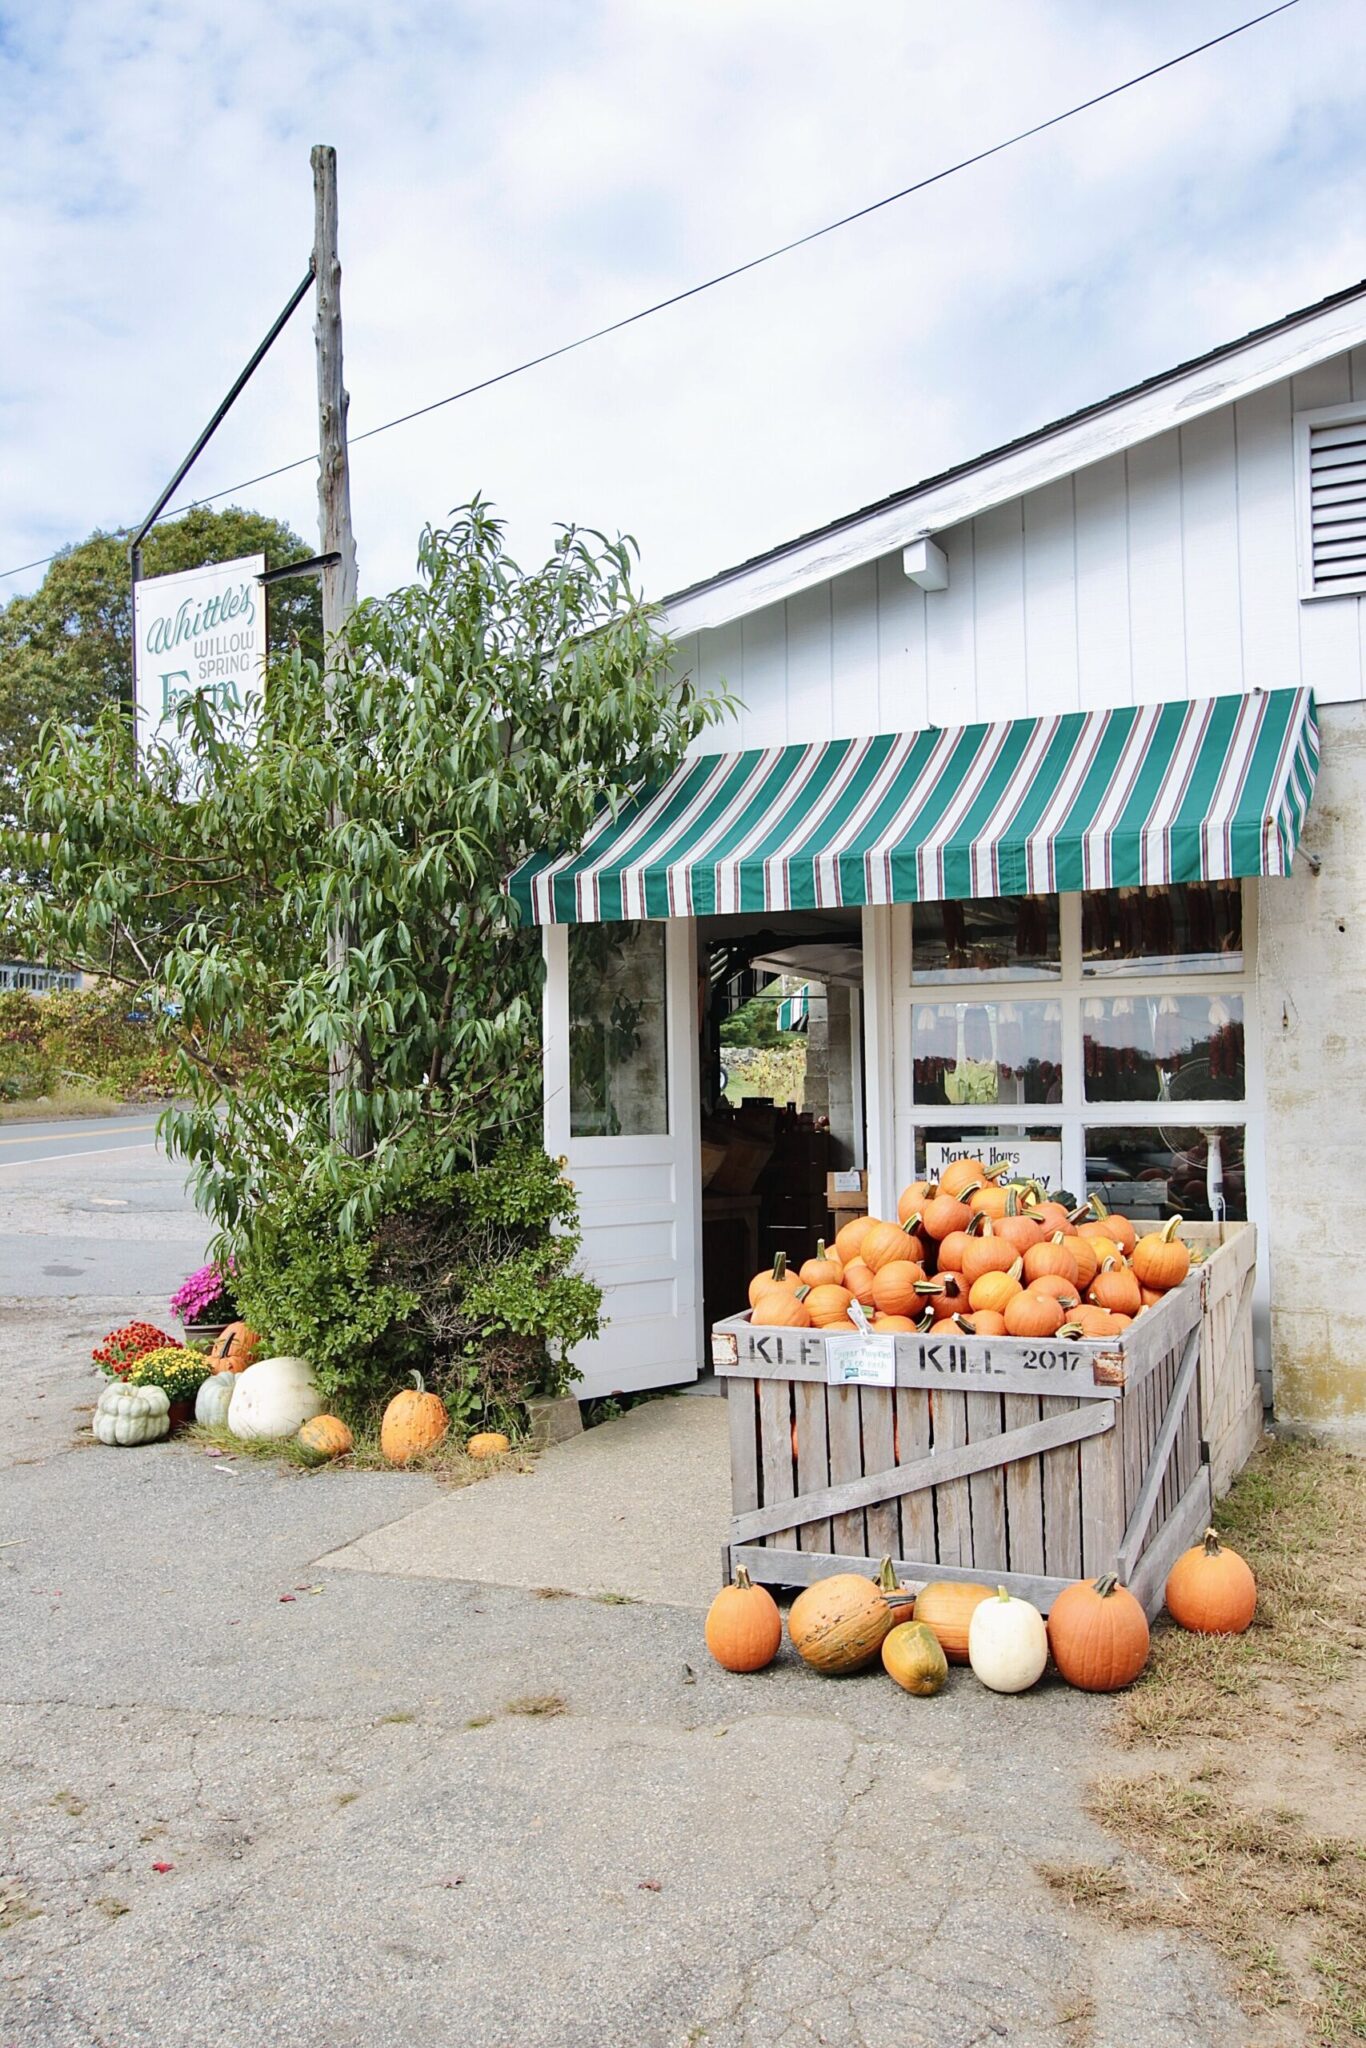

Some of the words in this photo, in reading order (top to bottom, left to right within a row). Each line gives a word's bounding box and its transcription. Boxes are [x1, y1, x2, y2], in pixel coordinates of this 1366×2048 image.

[147, 584, 255, 654] Whittle's
[194, 630, 254, 659] WILLOW
[198, 653, 250, 680] SPRING
[989, 1147, 1020, 1166] Hours
[919, 1344, 1006, 1375] KILL
[1023, 1350, 1081, 1371] 2017
